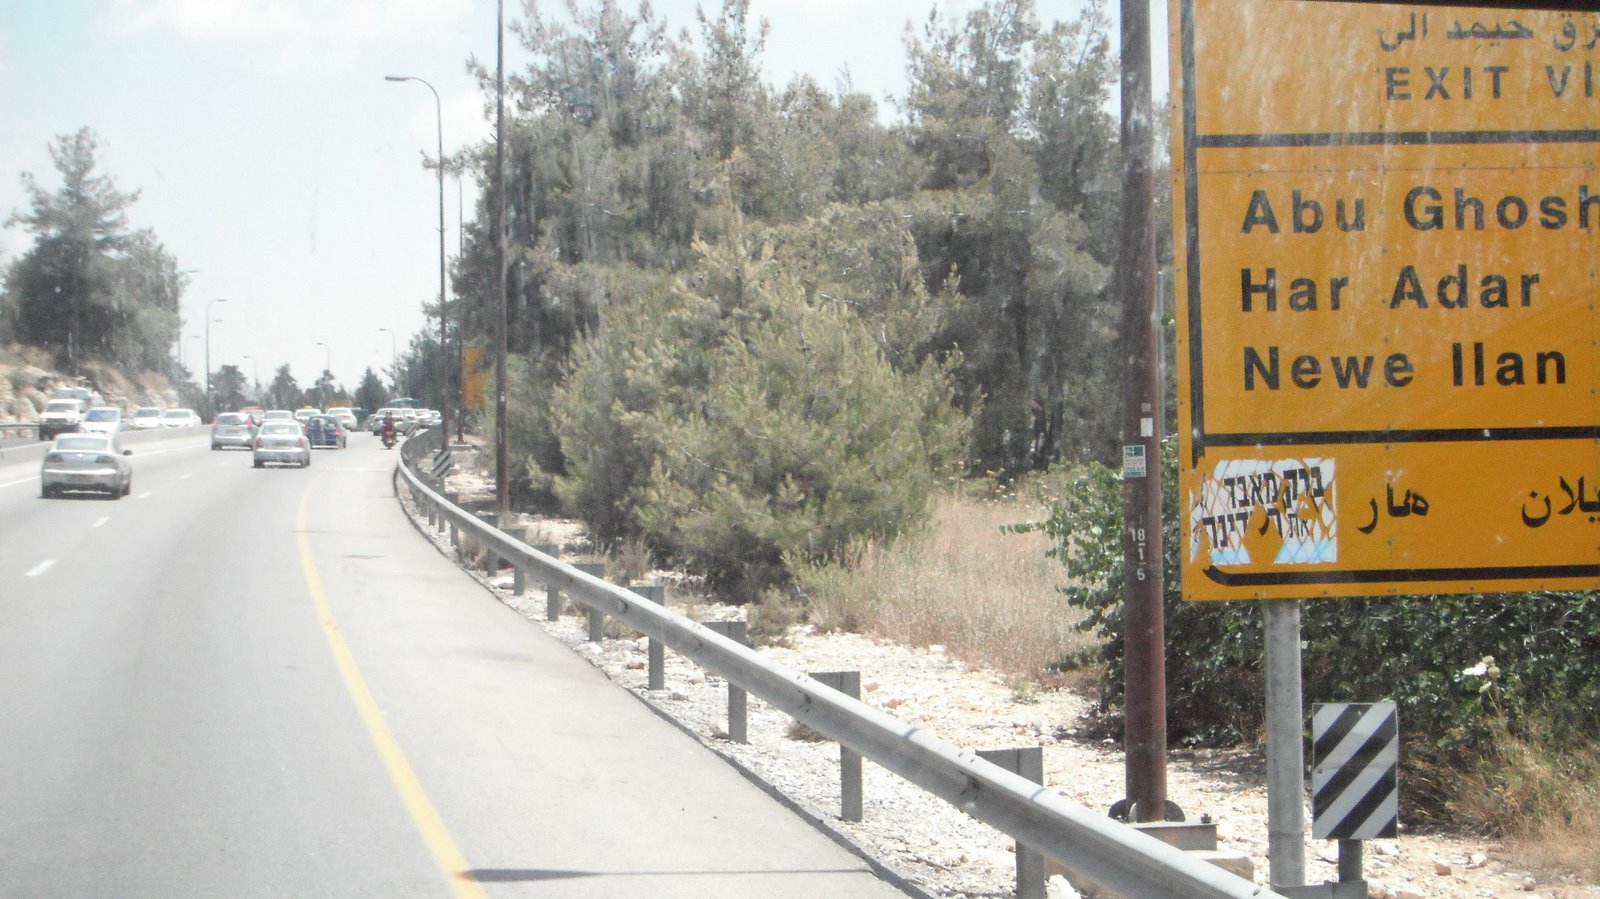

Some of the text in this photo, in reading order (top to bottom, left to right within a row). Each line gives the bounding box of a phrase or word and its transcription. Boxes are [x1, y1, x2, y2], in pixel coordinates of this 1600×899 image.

[1386, 66, 1509, 100] EXIT
[1240, 184, 1600, 234] Abu Ghosh
[1241, 264, 1540, 312] Har Adar
[1243, 342, 1567, 391] Newe Ilan
[1358, 482, 1430, 534] هار
